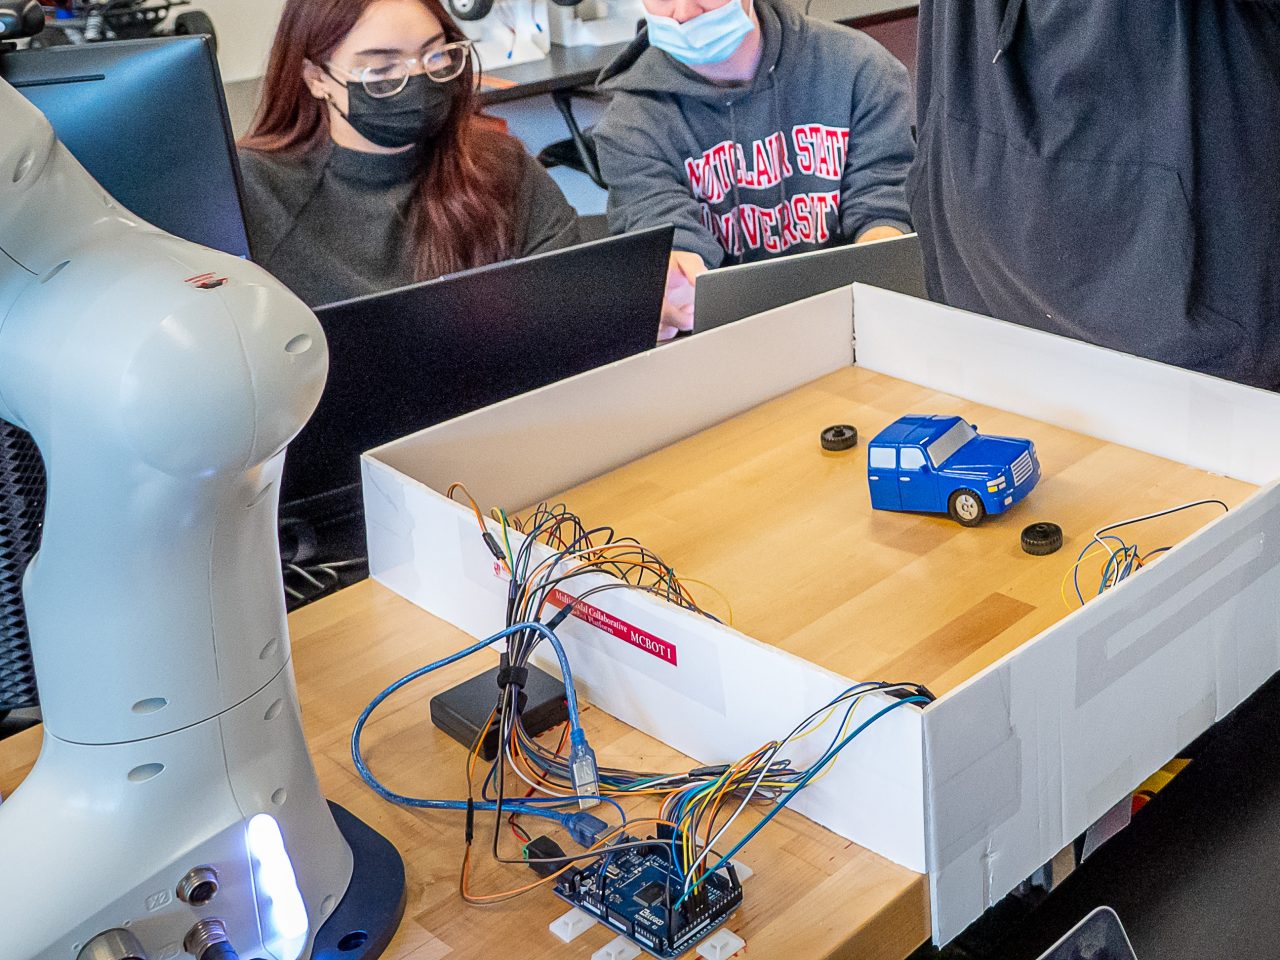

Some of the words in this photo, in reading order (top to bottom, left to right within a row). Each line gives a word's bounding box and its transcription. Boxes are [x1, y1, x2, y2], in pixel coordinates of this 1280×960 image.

[555, 590, 589, 614] Multiodal
[588, 607, 628, 633] Collaborative
[630, 630, 666, 657] MCBOT
